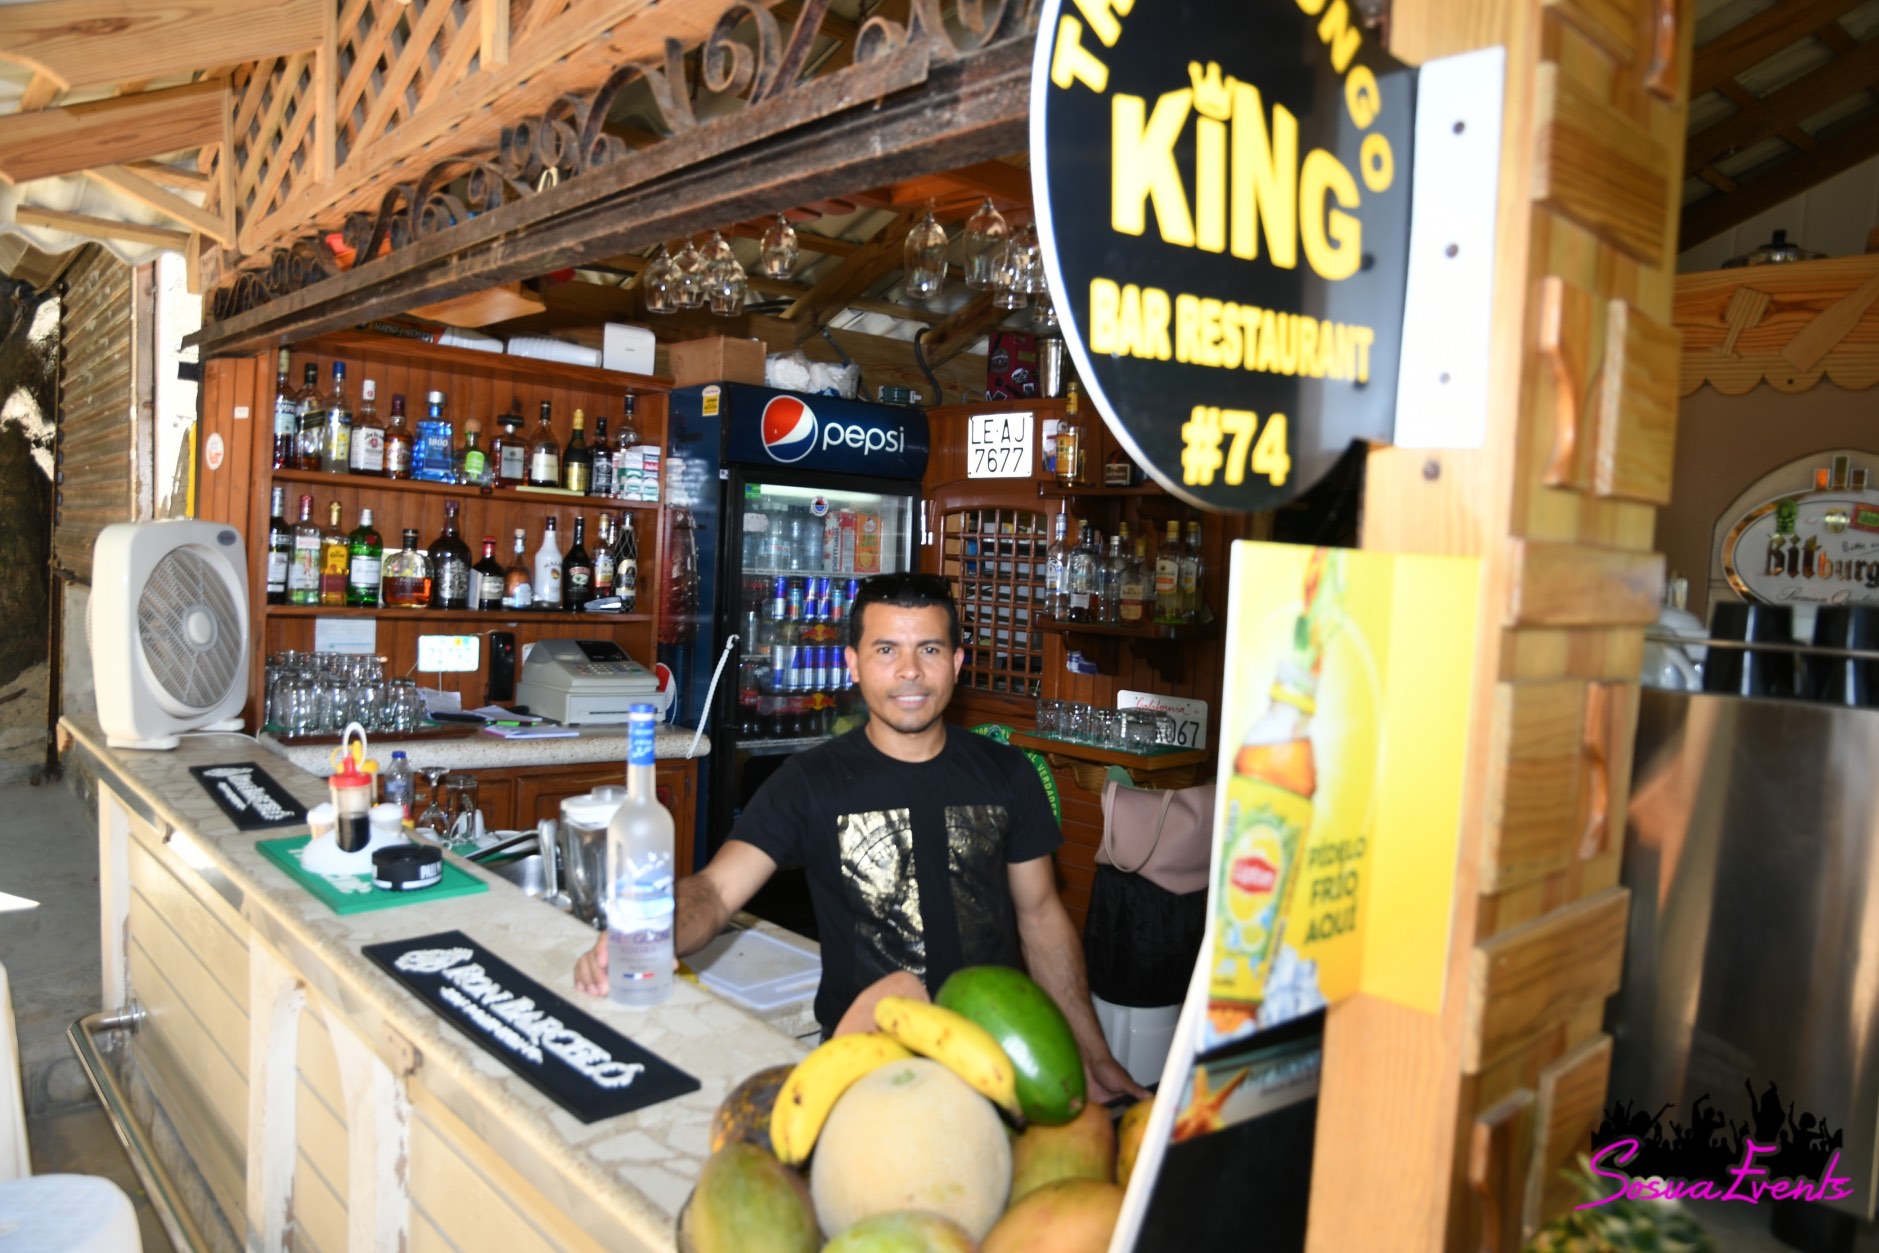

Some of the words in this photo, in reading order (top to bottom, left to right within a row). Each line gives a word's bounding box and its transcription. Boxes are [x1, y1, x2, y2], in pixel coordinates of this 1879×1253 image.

[1089, 278, 1171, 361] BAR
[1175, 294, 1374, 384] RESTAURANT
[428, 437, 448, 447] 1800
[822, 422, 905, 456] pepsi
[1181, 406, 1291, 487] #74
[975, 447, 1024, 473] 7677
[1137, 698, 1188, 716] California
